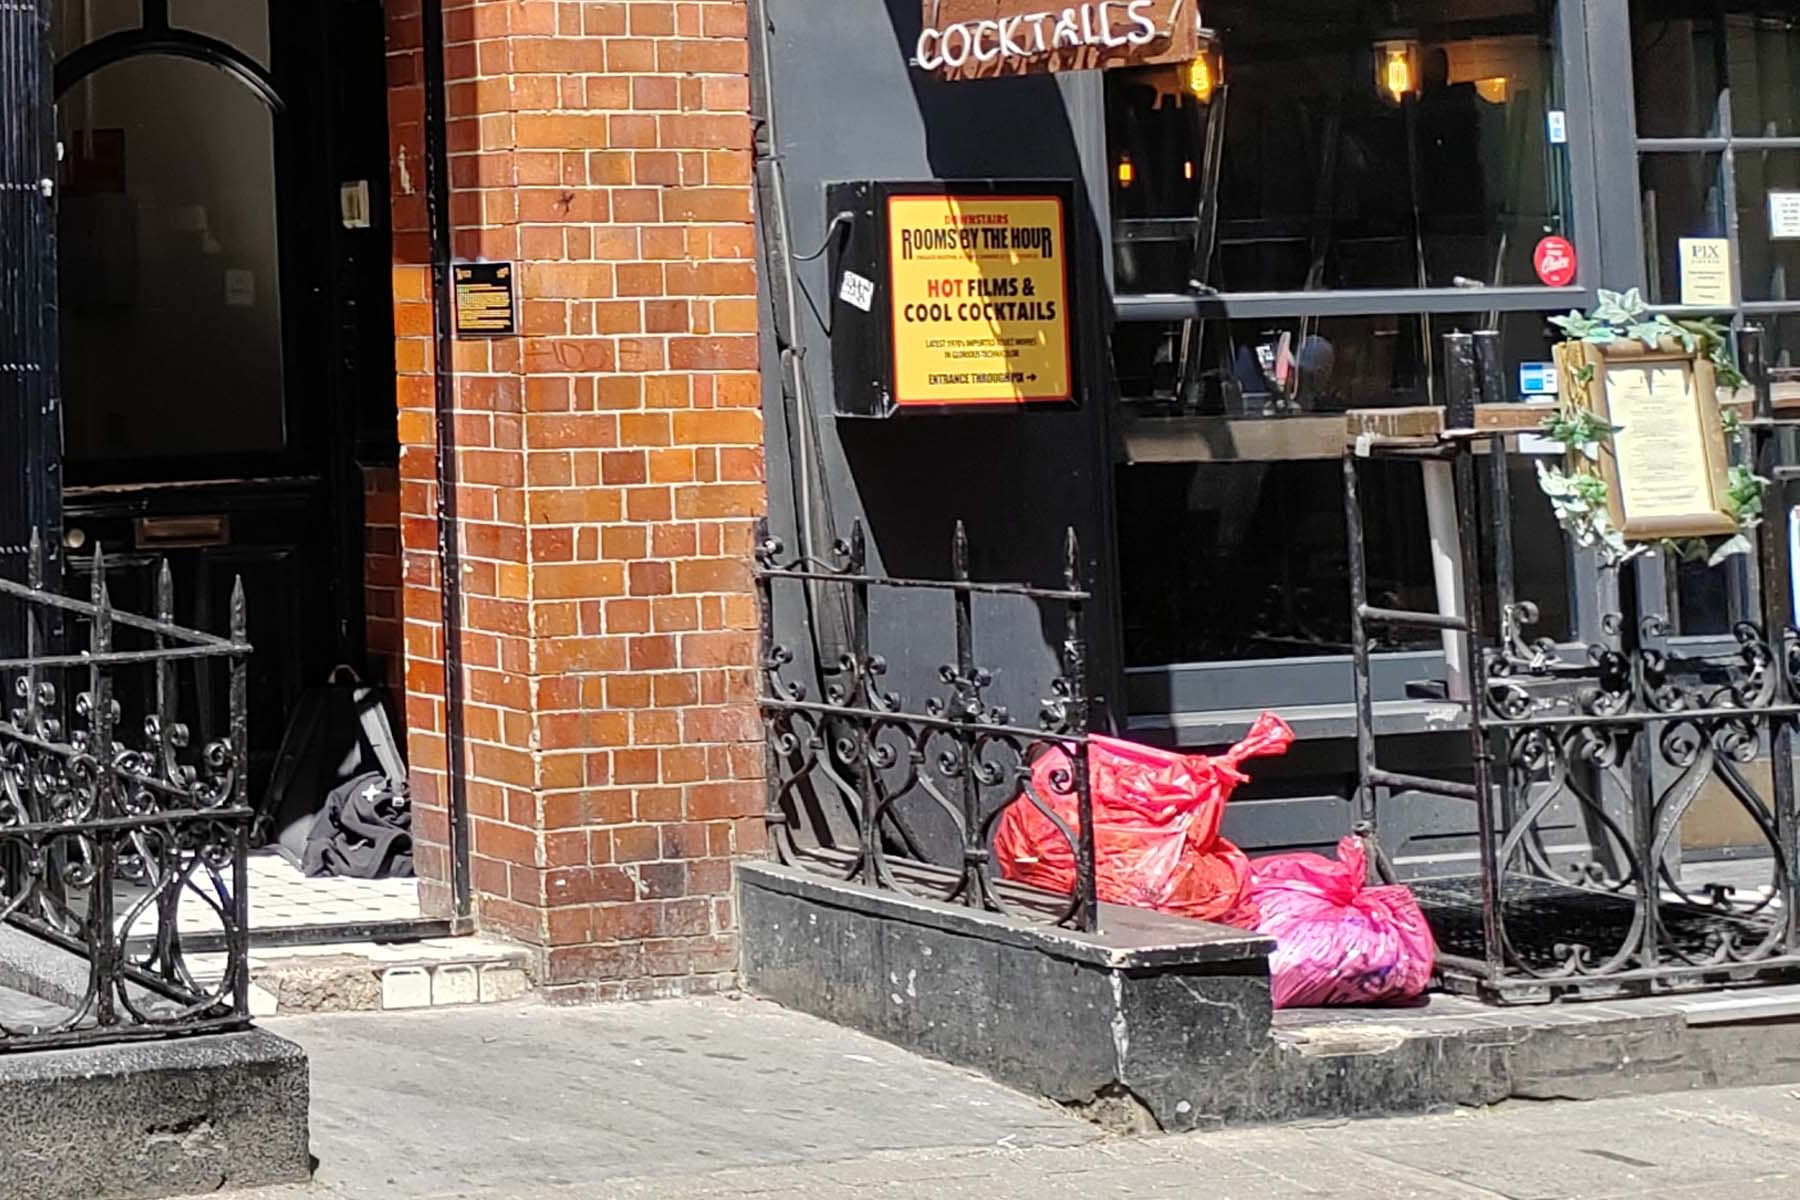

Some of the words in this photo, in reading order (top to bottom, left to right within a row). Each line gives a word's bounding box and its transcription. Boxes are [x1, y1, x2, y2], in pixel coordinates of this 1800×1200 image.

[917, 0, 1155, 70] COCKTAILS
[902, 228, 957, 259] ROOMS
[960, 228, 979, 249] BY
[981, 227, 1008, 249] THE
[1011, 227, 1052, 258] HOUR
[1692, 245, 1719, 257] PIX
[928, 279, 963, 297] HOT
[967, 278, 1018, 297] FILMS
[1022, 277, 1035, 296] &
[904, 303, 952, 322] COOL
[957, 302, 1056, 321] COCKTAILS
[928, 373, 969, 384] ENTRANCE
